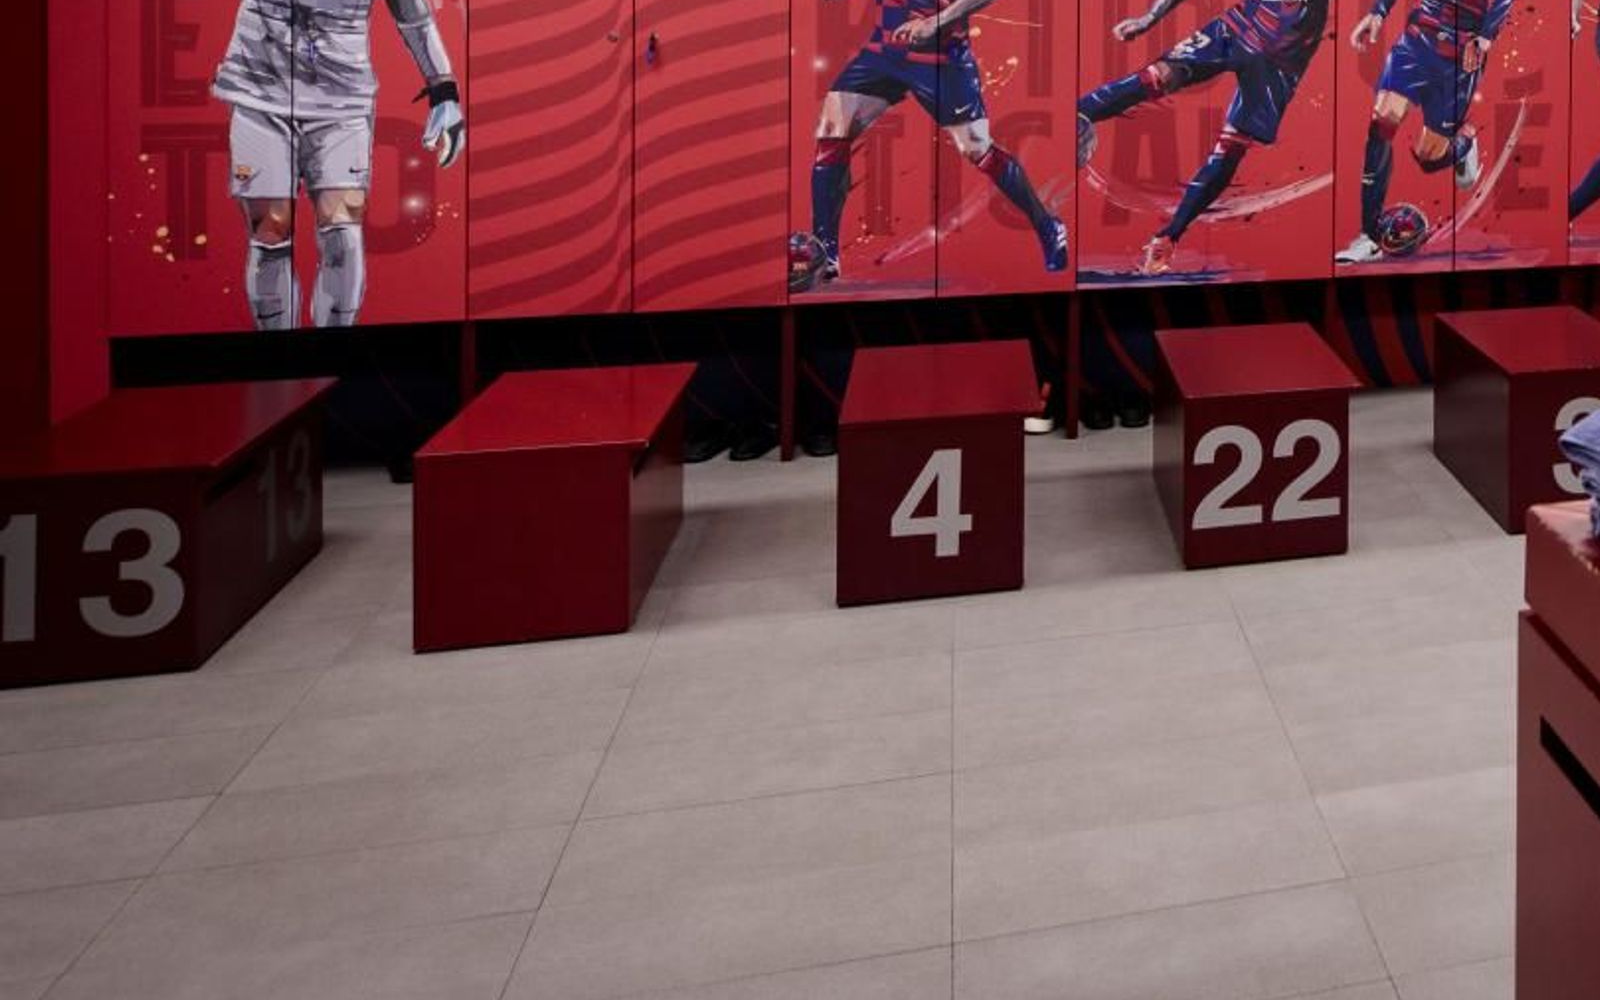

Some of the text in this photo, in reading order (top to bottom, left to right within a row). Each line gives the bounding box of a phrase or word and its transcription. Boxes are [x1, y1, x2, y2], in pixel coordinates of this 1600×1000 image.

[890, 448, 973, 558] 4
[1191, 418, 1341, 531] 22
[0, 508, 185, 642] 13
